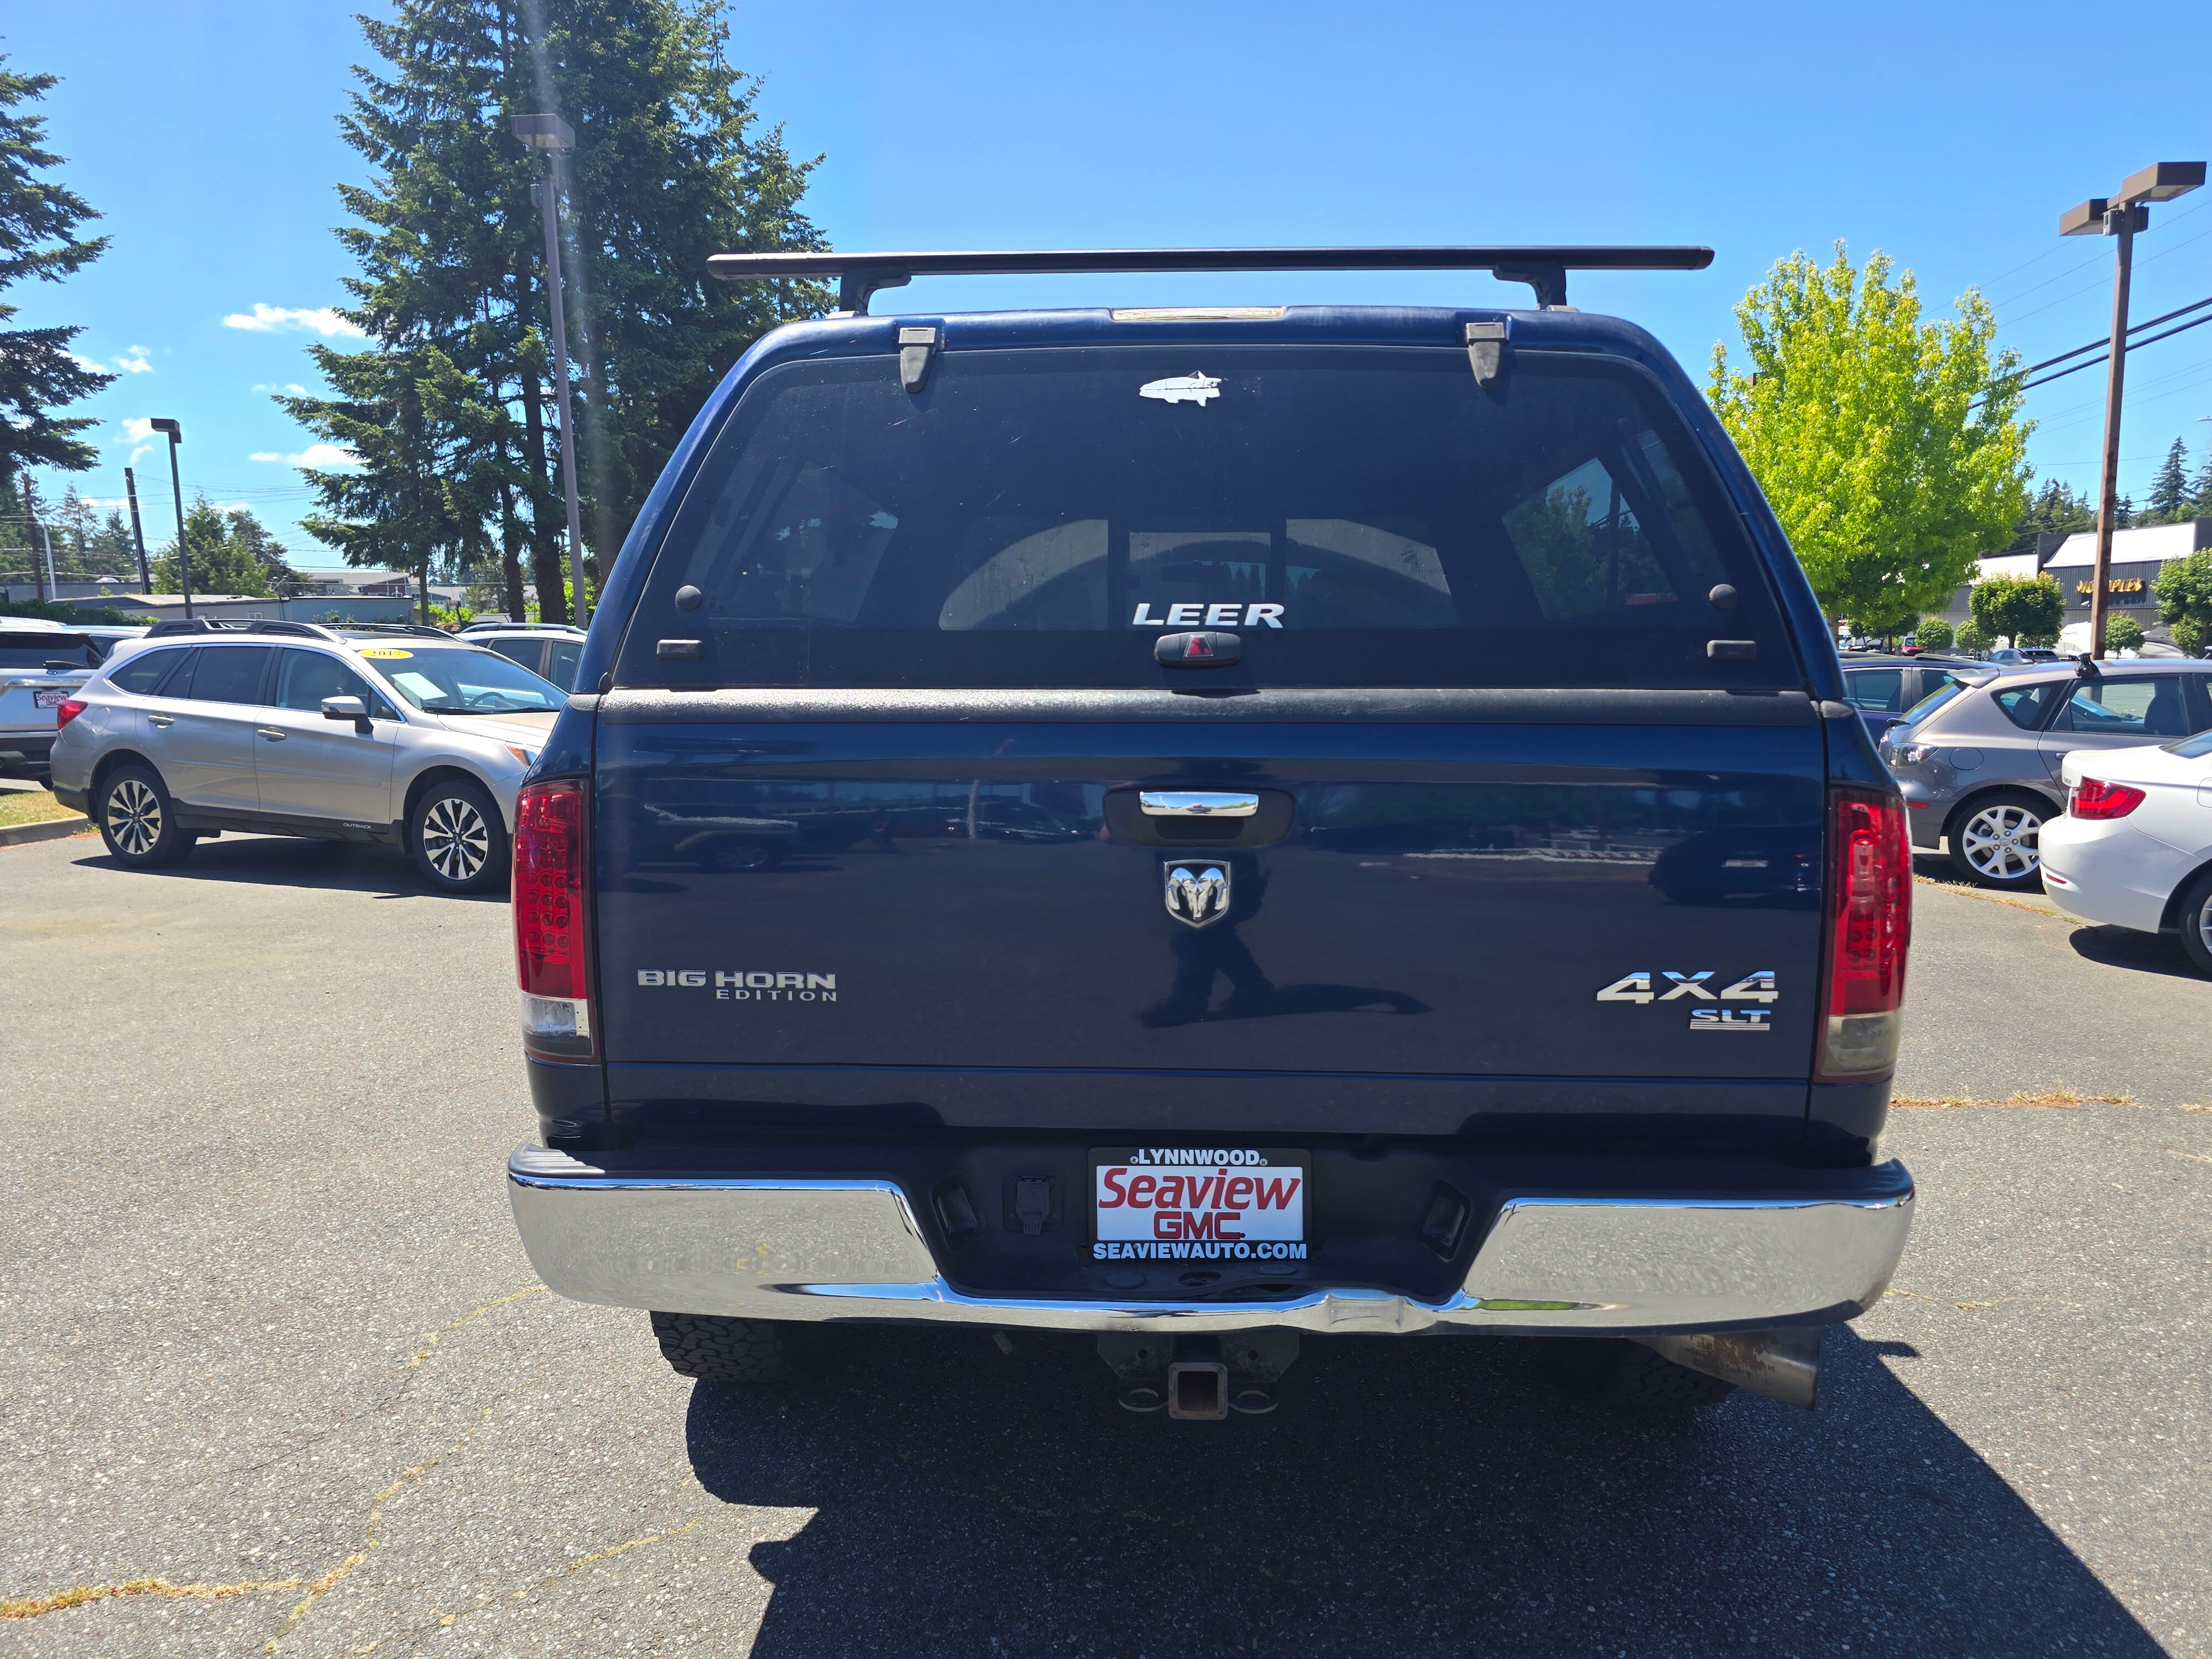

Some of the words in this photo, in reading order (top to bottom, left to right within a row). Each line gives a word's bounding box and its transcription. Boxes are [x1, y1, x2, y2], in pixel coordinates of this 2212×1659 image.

[1132, 602, 1285, 628] LEER
[638, 969, 706, 987] BIG
[715, 971, 836, 989] HORN
[1597, 971, 1778, 1004] 4X4
[716, 989, 837, 1001] EDITION
[1691, 1009, 1771, 1022] SLT
[1139, 1149, 1260, 1165] LYNNWOOD
[1098, 1167, 1301, 1210] Seaview
[1154, 1211, 1241, 1239] GMC
[1093, 1243, 1307, 1259] SEAVIEWAUTO.COM
